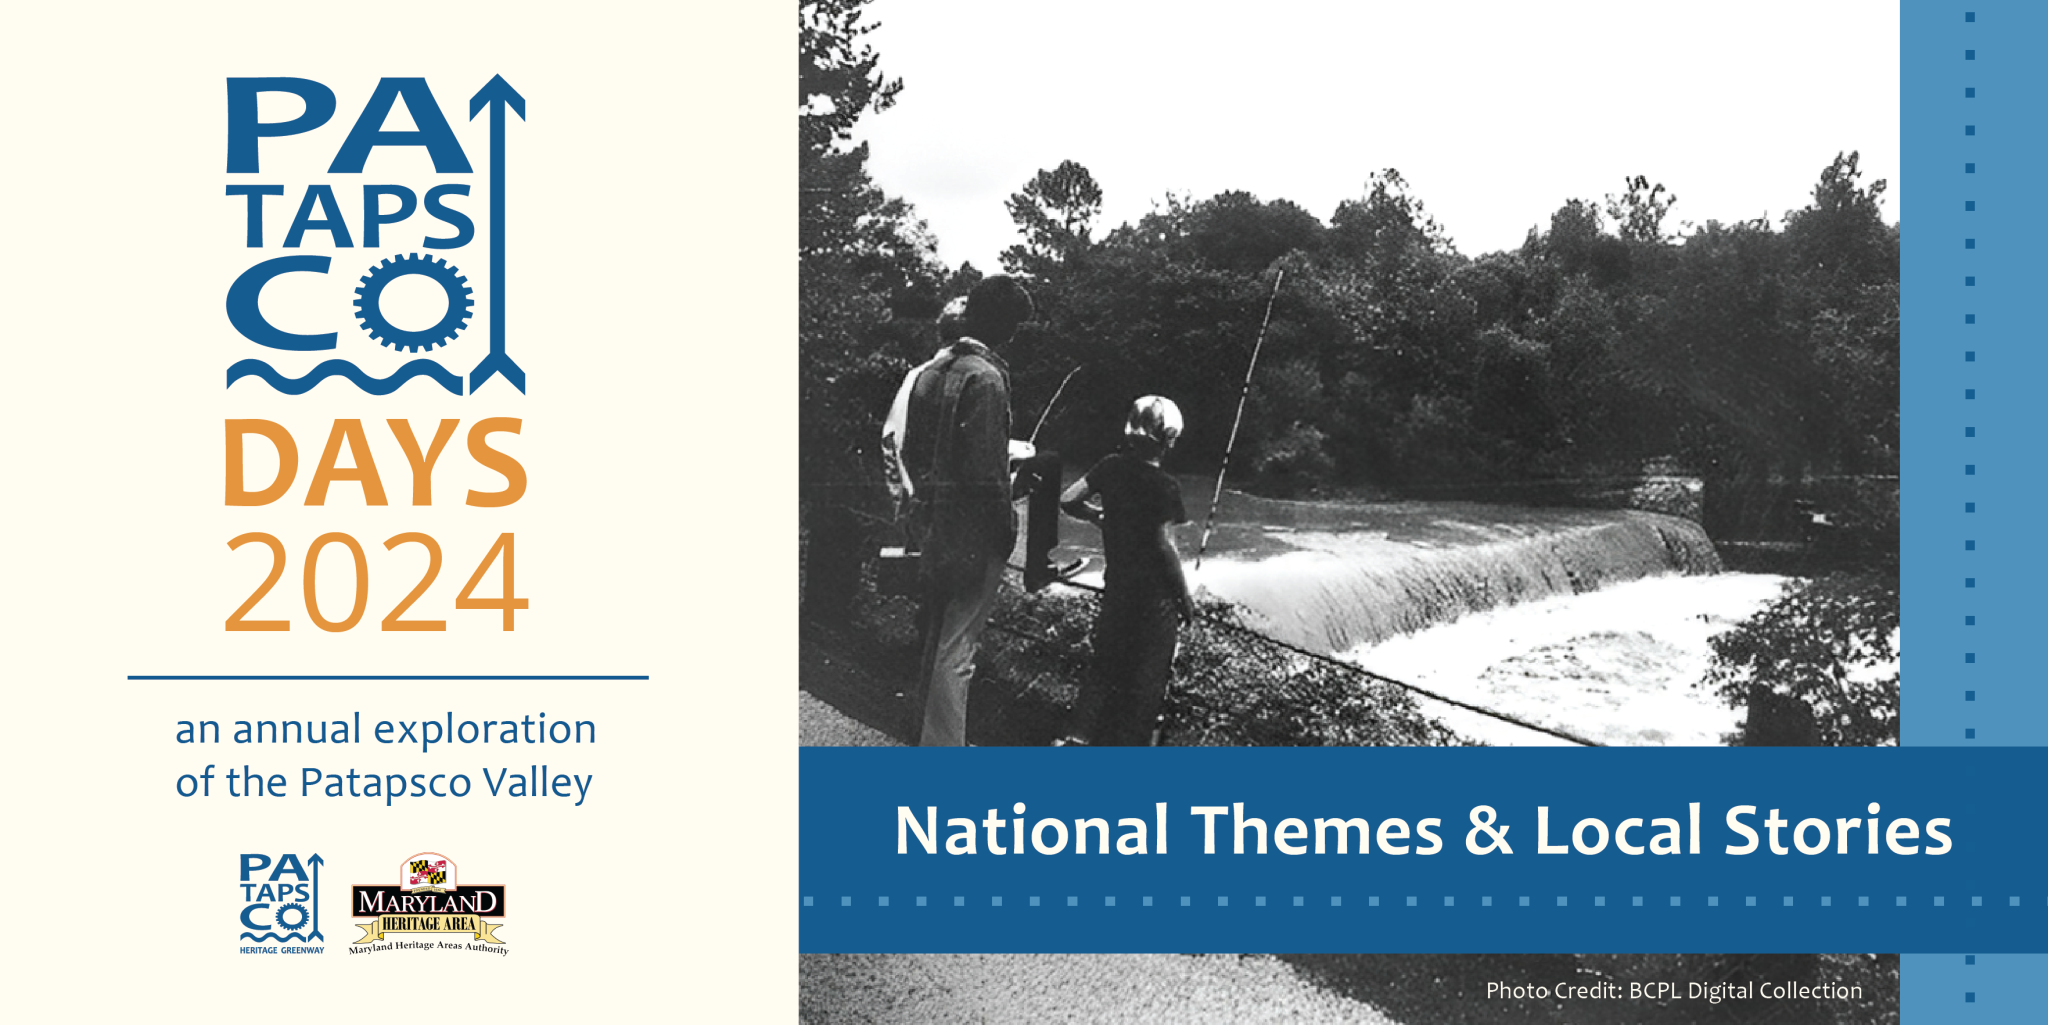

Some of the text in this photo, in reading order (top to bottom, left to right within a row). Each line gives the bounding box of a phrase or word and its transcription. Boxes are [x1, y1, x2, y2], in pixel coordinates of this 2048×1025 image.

[226, 77, 474, 173] PA
[226, 184, 475, 249] TAPS
[226, 253, 475, 353] CO
[225, 417, 527, 507] DAYS
[225, 532, 529, 632] 2024
[176, 712, 596, 753] an annual exploration
[176, 764, 593, 807] of the Patapsco Valley
[896, 803, 1952, 856] National Themes & Local Stories
[240, 853, 309, 881] PA
[240, 883, 311, 902] TAPS
[359, 890, 497, 913] MARYLAND
[382, 917, 476, 931] HERITAGE AREA
[240, 946, 325, 955] HERITAGE GREENWAY
[349, 940, 509, 957] Maryland Heritage Areas Authority
